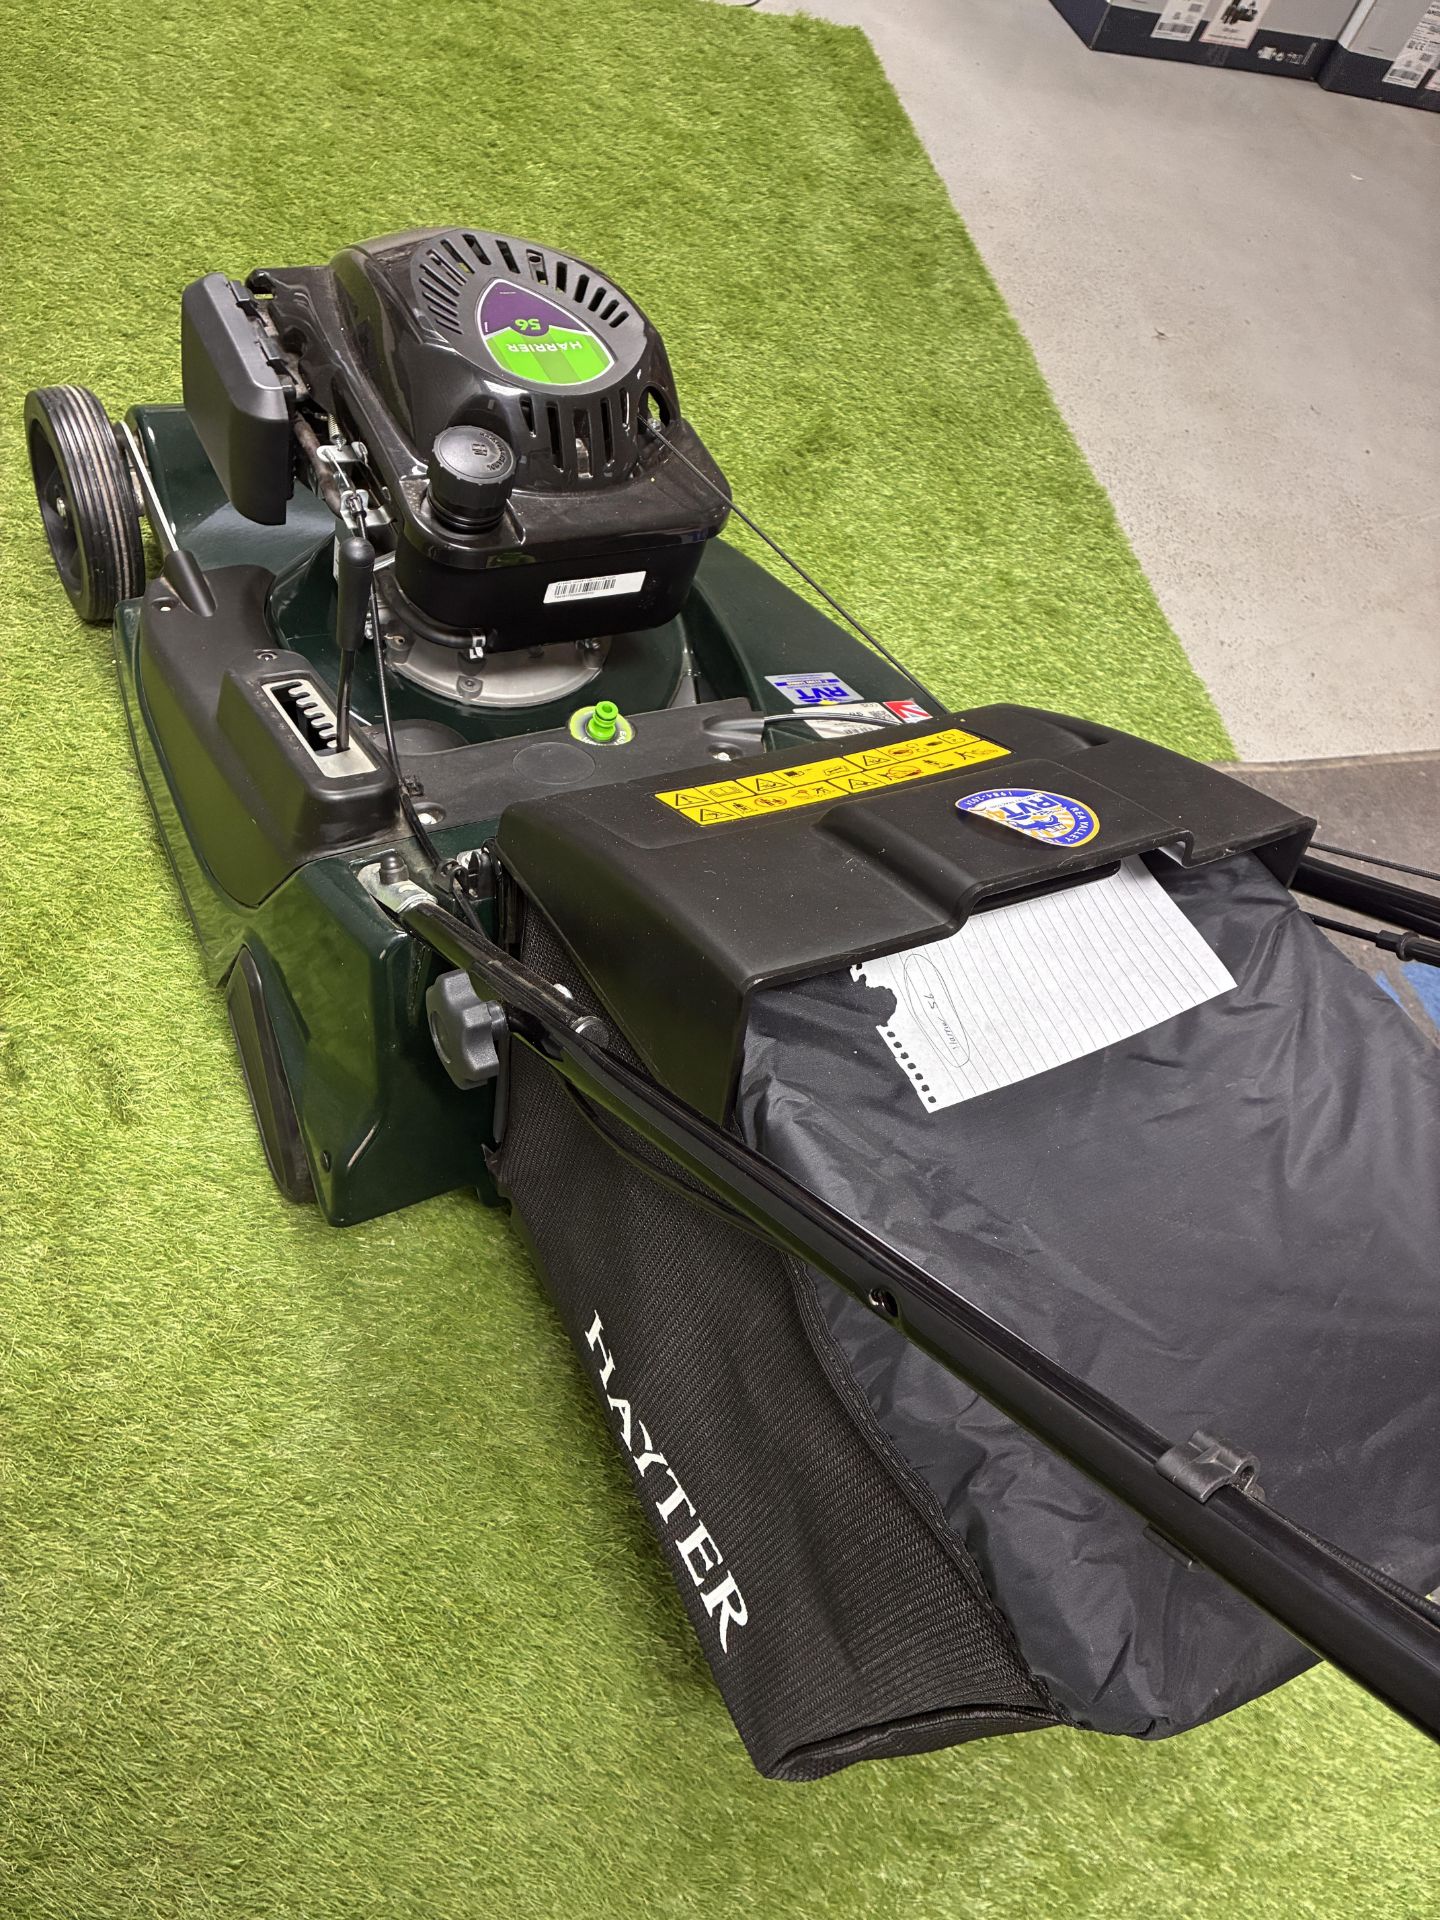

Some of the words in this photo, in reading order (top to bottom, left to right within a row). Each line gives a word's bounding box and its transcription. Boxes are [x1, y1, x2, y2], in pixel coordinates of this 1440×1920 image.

[515, 319, 541, 331] 56
[507, 340, 583, 353] HARRIER
[795, 686, 850, 700] RVT
[1000, 796, 1060, 820] RVT
[1070, 806, 1086, 820] REA
[1065, 821, 1089, 842] VALLEY
[584, 1309, 749, 1654] HAYTER
